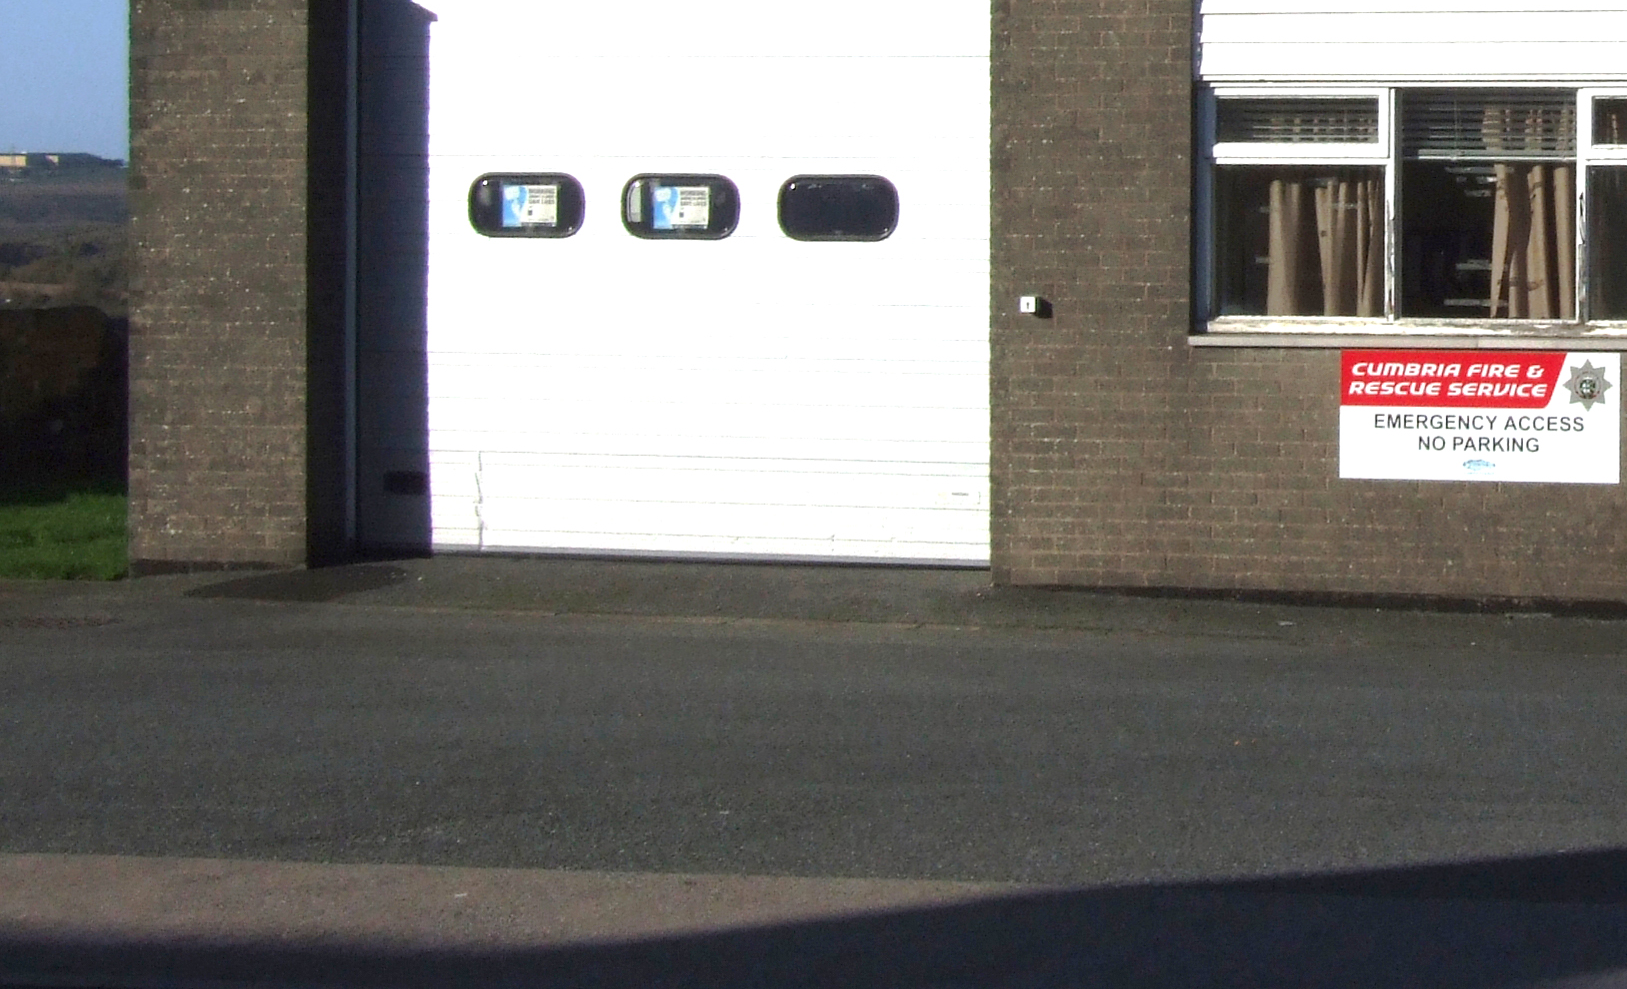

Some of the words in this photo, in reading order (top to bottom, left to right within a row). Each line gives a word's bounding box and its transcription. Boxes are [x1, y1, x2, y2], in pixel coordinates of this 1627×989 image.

[1352, 362, 1461, 378] CUMBRIA
[1467, 363, 1521, 378] FIRE
[1526, 364, 1545, 379] &
[1349, 381, 1442, 396] RESCUE
[1447, 382, 1548, 398] SERVICE
[1374, 414, 1497, 431] EMERGENCY
[1504, 416, 1585, 432] ACCESS
[1418, 436, 1446, 451] NO
[1453, 437, 1540, 453] PARKING
